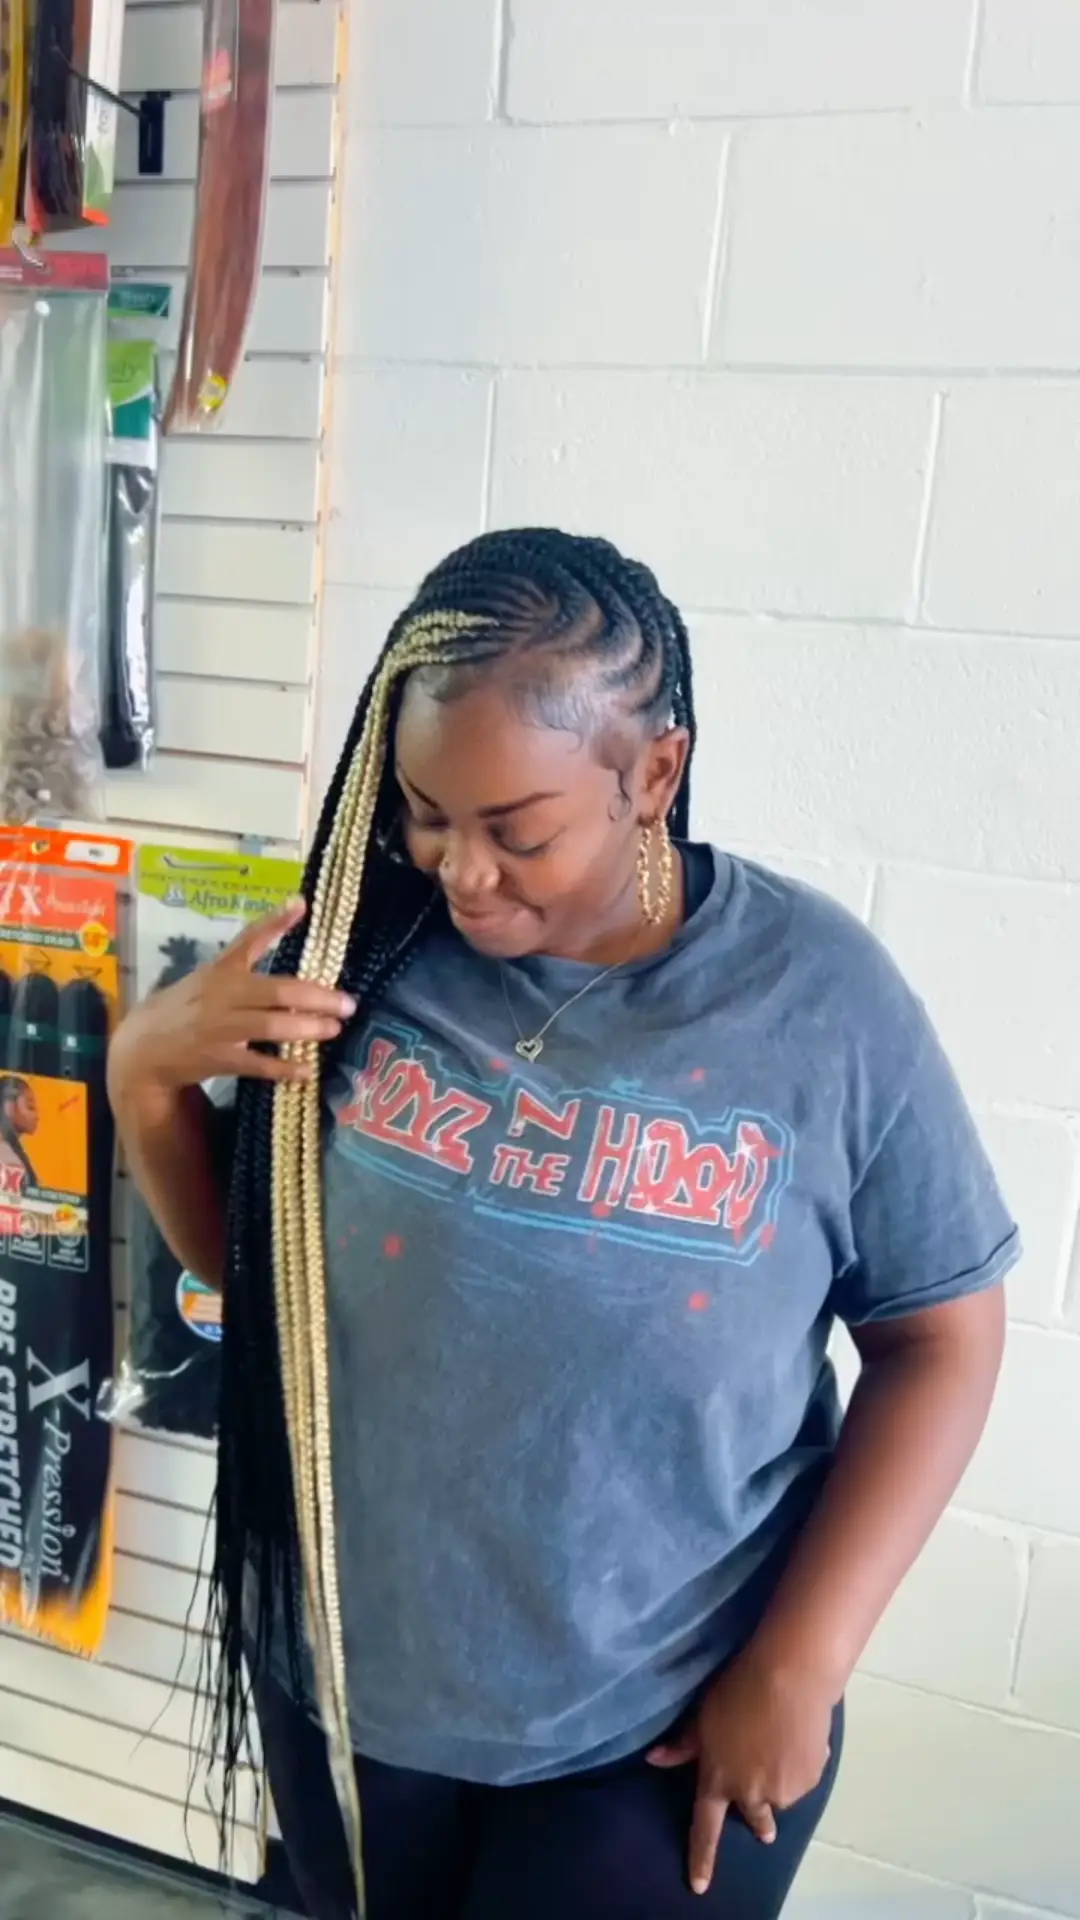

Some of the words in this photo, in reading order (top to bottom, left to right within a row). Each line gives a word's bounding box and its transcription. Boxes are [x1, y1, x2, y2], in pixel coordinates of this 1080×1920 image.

[508, 1088, 582, 1141] N
[489, 1144, 572, 1197] THE
[577, 1105, 772, 1230] HOOD
